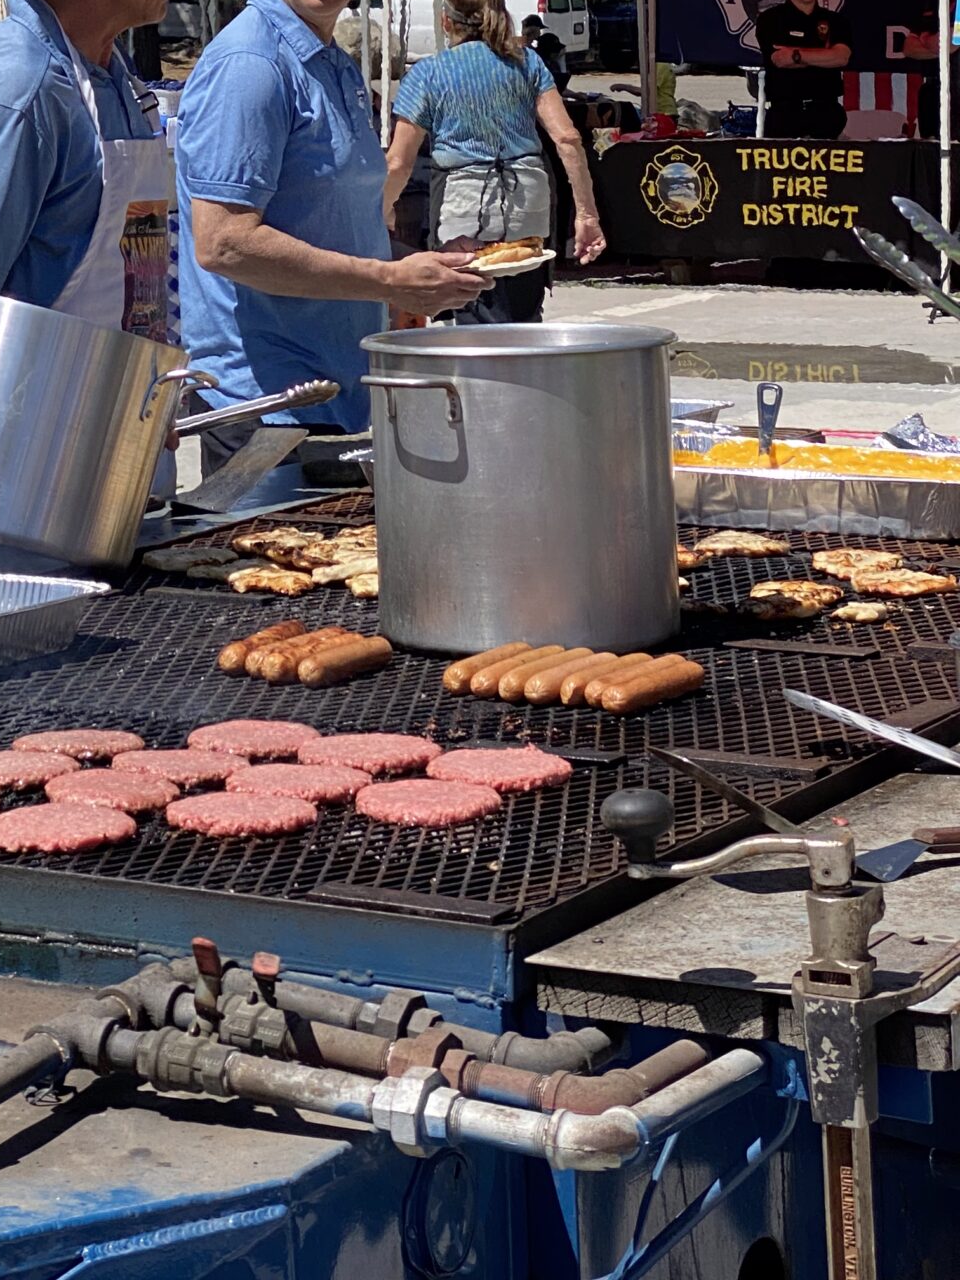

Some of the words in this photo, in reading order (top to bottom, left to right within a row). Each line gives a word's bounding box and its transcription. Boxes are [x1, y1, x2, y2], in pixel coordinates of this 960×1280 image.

[736, 147, 864, 173] TRUCKEE
[772, 176, 828, 199] FIRE
[743, 204, 859, 229] DISTRICT
